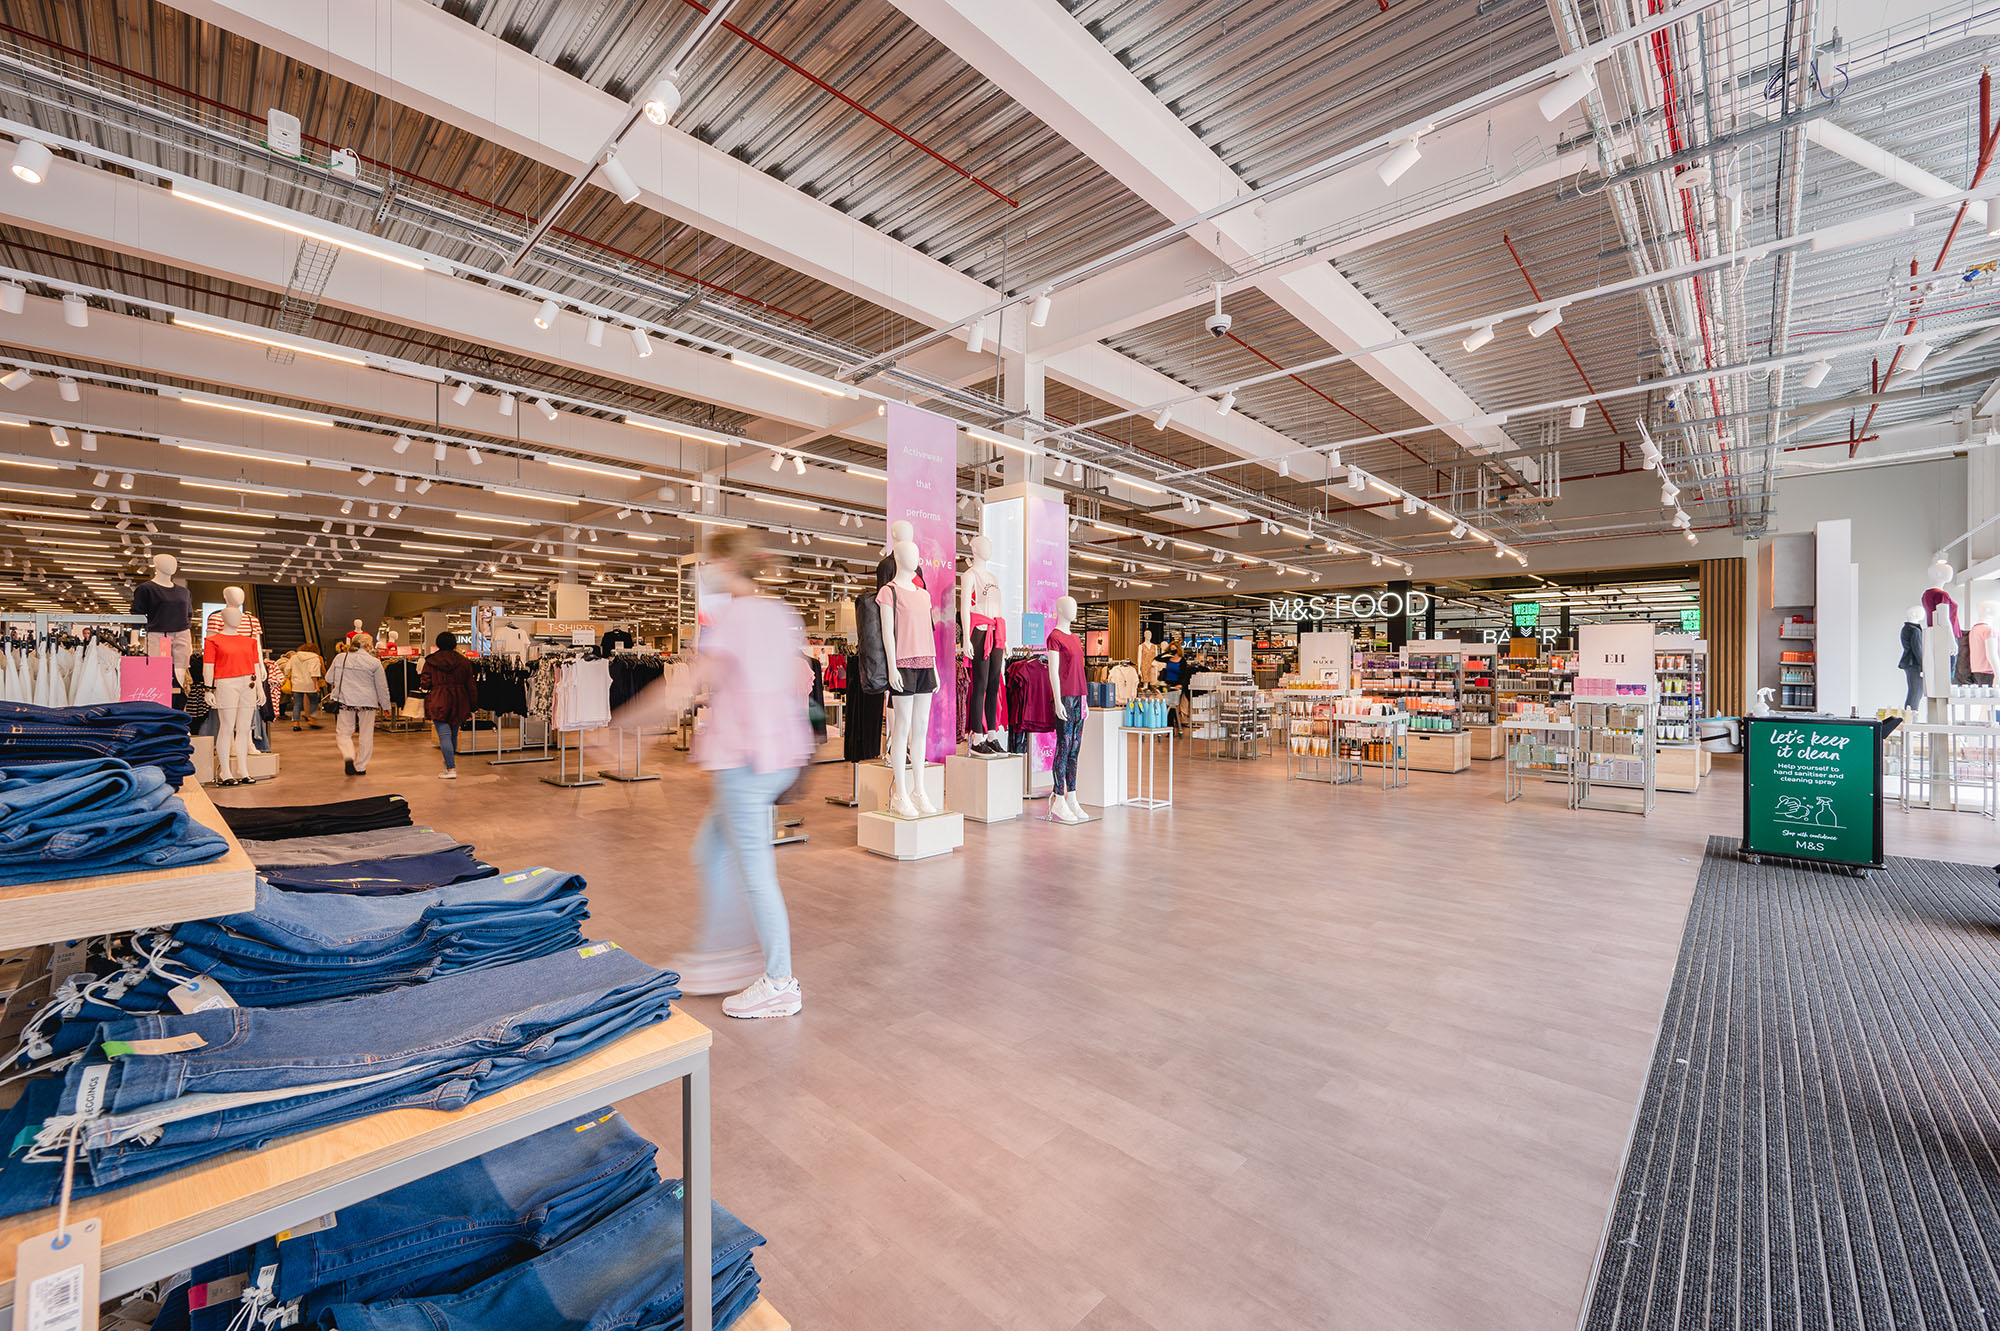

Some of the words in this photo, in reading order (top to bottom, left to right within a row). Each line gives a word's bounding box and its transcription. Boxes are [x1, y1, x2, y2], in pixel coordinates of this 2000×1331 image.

[903, 446, 943, 463] Activewear
[916, 480, 932, 490] that
[906, 508, 941, 521] performs
[918, 557, 953, 570] DMOVE
[1269, 597, 1326, 621] M&S
[1336, 591, 1429, 619] FOOD
[547, 623, 596, 632] T-SHIRTS
[1483, 628, 1572, 645] BAR
[1770, 729, 1805, 744] Let's
[1811, 732, 1850, 749] keep
[1777, 745, 1793, 758] it
[1797, 747, 1840, 760] clean
[1780, 776, 1813, 784] cleaning
[1782, 829, 1796, 837] Shop
[1796, 840, 1825, 852] M&S
